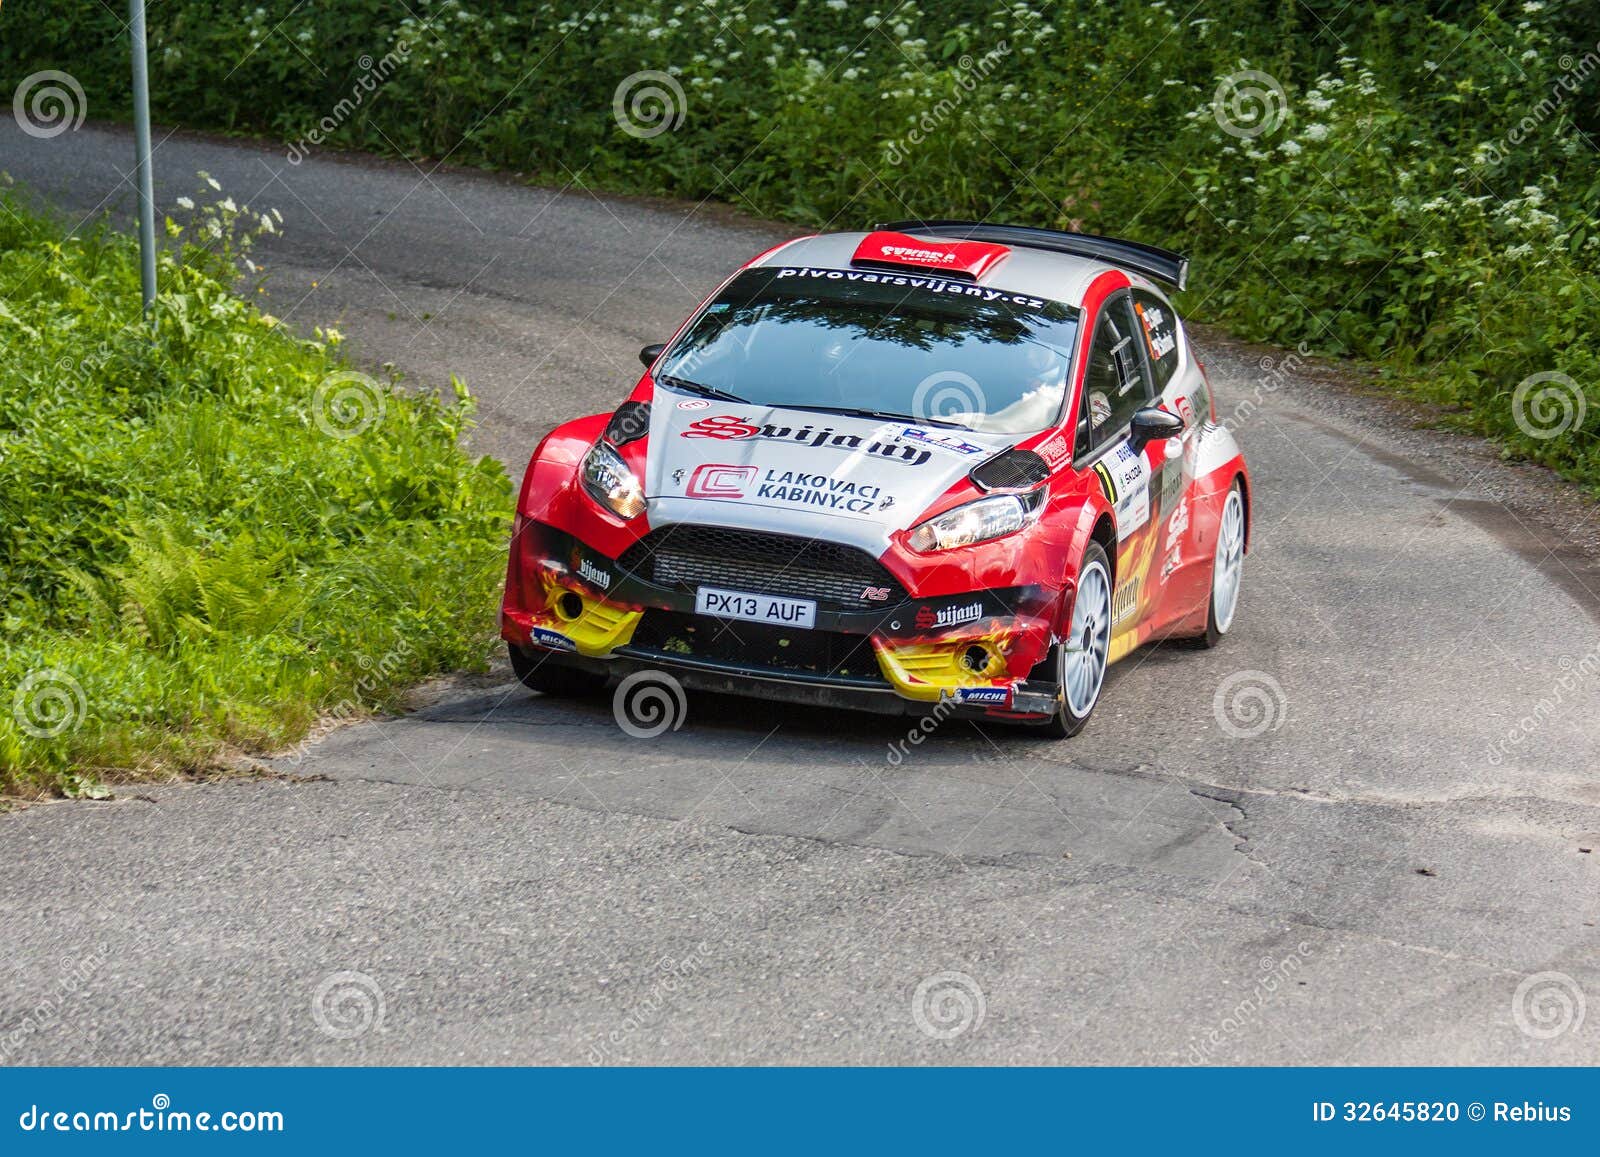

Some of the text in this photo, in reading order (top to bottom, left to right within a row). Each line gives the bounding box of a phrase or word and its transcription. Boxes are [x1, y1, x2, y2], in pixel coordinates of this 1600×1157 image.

[777, 267, 1044, 309] pivovarsvijany.cz
[680, 415, 932, 466] Svijany
[764, 469, 880, 499] LAKOVACI
[757, 484, 876, 515] KABINY.CZ
[705, 593, 807, 621] PX13 AUF
[860, 586, 891, 600] RS
[915, 602, 984, 629] Svijany
